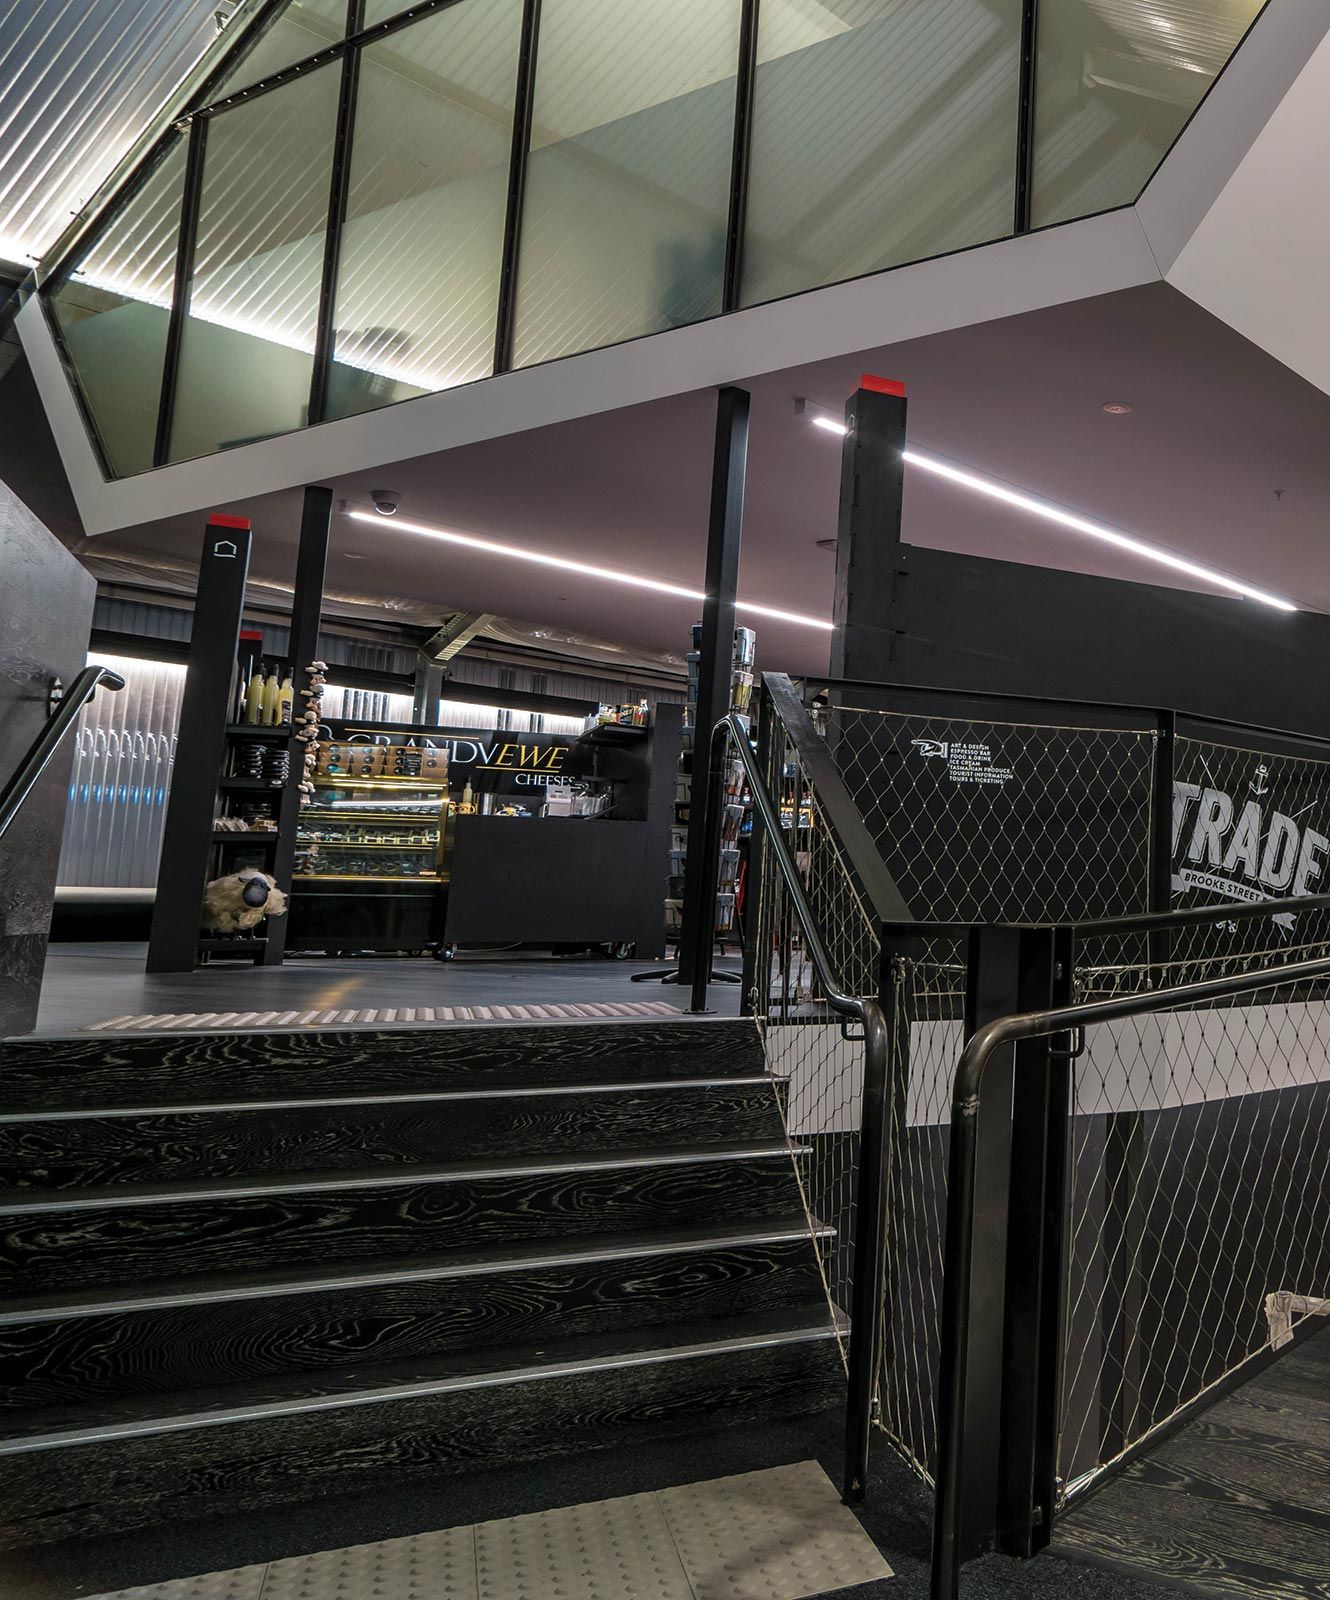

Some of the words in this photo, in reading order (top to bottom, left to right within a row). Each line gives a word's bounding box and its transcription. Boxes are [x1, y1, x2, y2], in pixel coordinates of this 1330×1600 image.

[515, 773, 575, 786] CHEESES
[1172, 780, 1330, 897] TRADE
[1184, 872, 1226, 891] BROOKE
[1227, 884, 1260, 901] STREET
